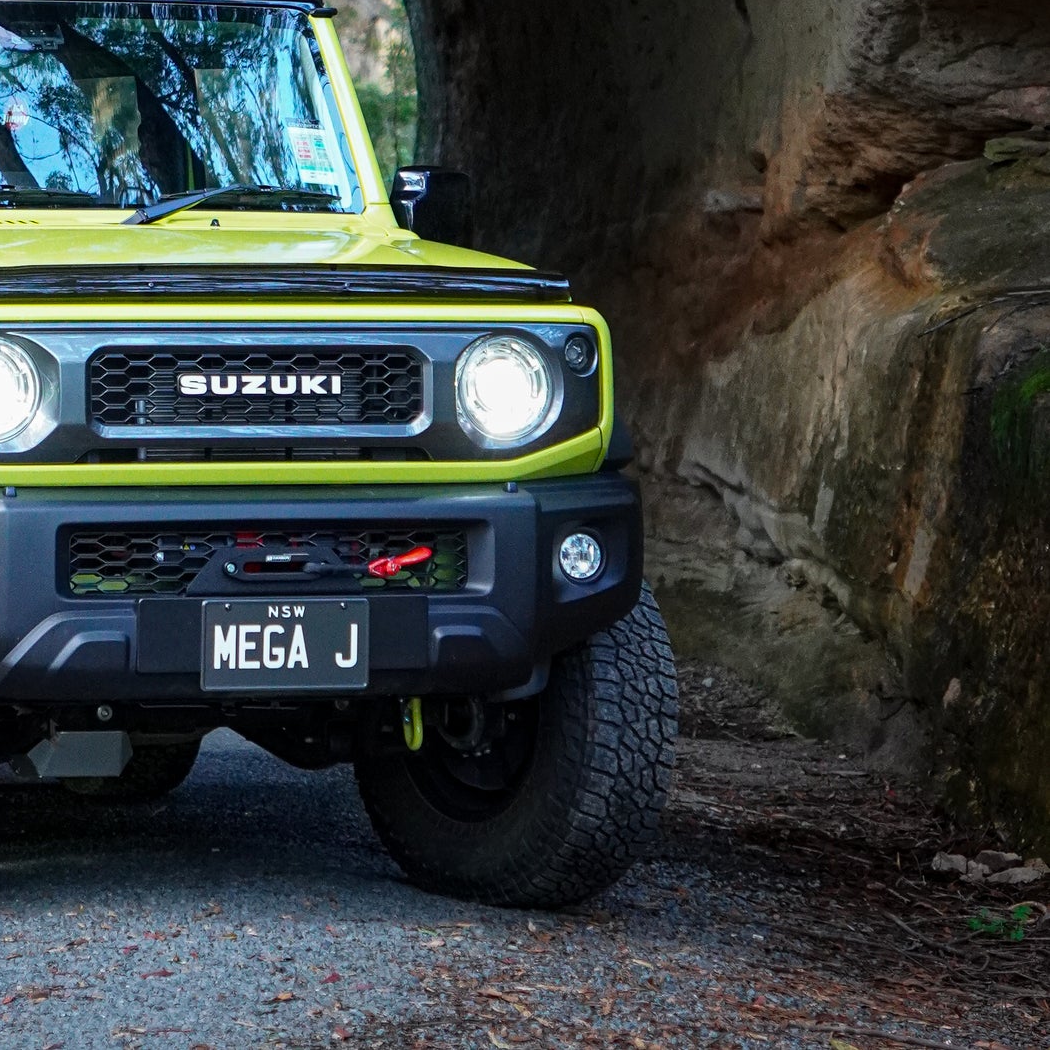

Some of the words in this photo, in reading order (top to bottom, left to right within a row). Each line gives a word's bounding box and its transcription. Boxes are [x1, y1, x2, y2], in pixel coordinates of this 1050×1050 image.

[179, 374, 342, 395] SUZUKI
[268, 605, 306, 618] NSW
[213, 624, 309, 670] MEGA
[335, 623, 358, 669] J
